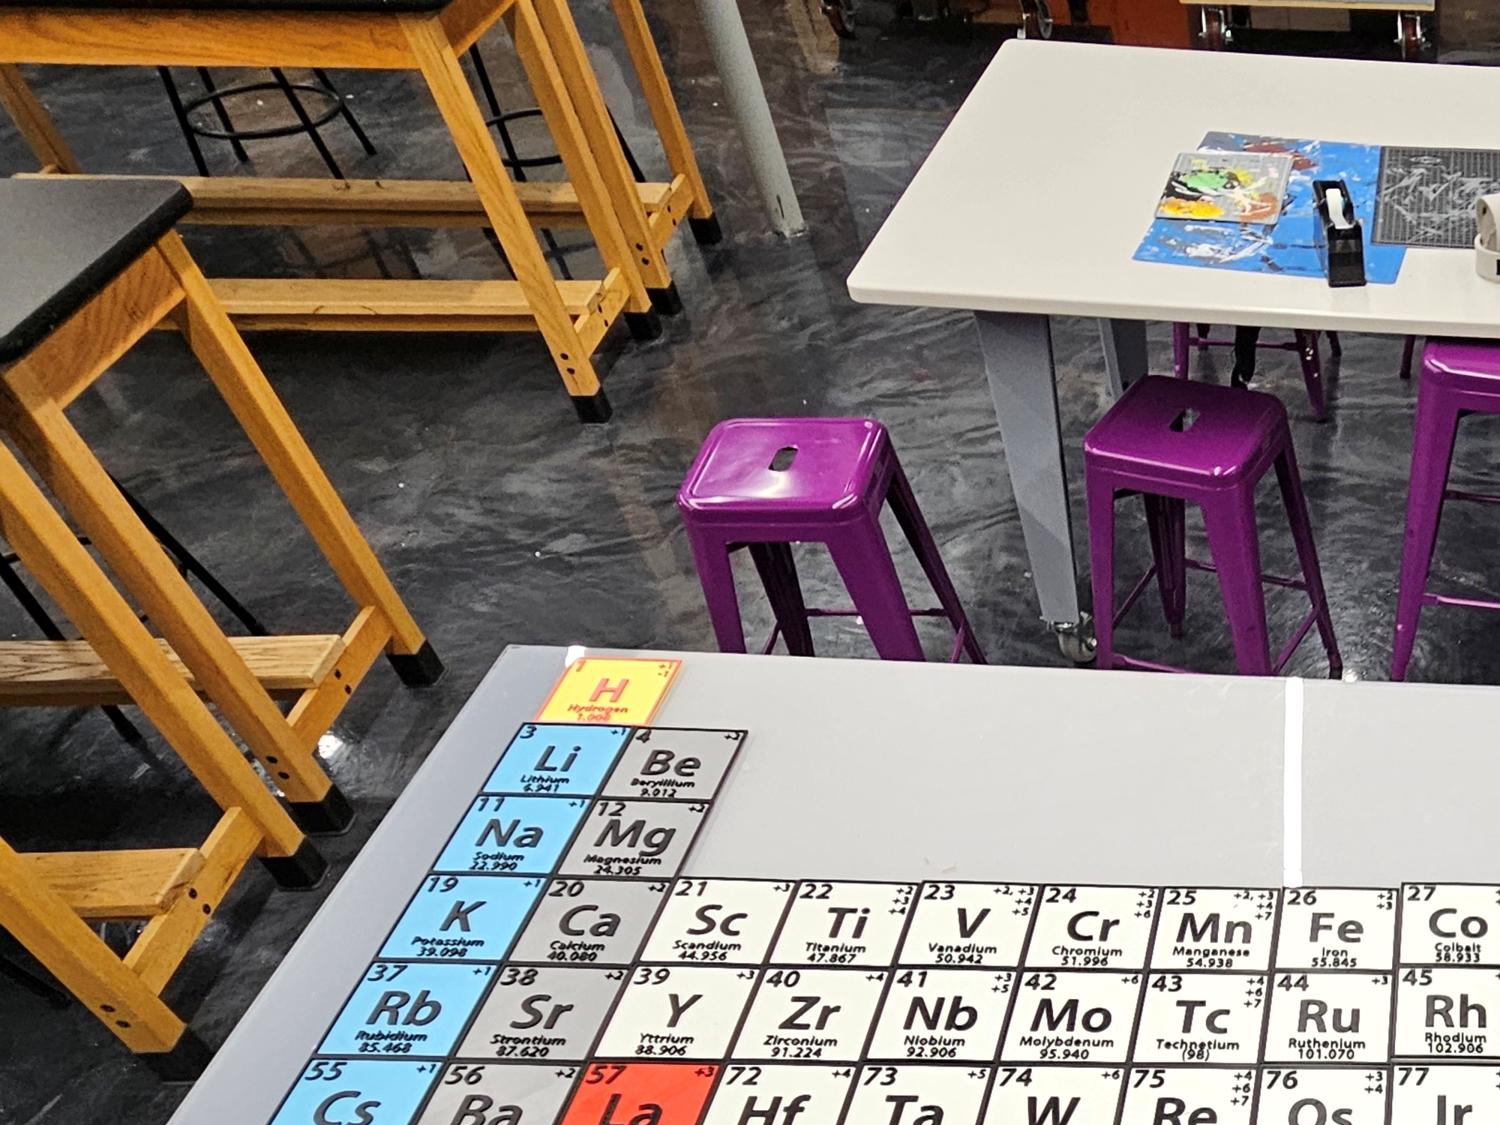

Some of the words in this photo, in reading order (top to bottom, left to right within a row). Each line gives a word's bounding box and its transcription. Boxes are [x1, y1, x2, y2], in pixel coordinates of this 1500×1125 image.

[589, 678, 630, 703] H
[534, 745, 582, 772] Li
[640, 749, 701, 777] Be
[475, 819, 544, 848] Na
[593, 819, 676, 857] Mg
[1407, 885, 1437, 902] 27
[439, 900, 487, 932] K
[828, 907, 871, 939] Ti
[1067, 910, 1120, 942] Cr
[1429, 908, 1488, 939] Co
[1309, 912, 1364, 943] Fe
[500, 968, 539, 986] 38
[766, 970, 801, 988] 40
[896, 970, 928, 988] 41
[510, 994, 574, 1030] Sr
[778, 996, 841, 1030] Zr
[903, 995, 978, 1031] Nb
[490, 1034, 566, 1046] Strontium
[763, 1035, 838, 1047] Zirconium
[904, 1035, 965, 1046] Niobium
[771, 1046, 822, 1058] 91.224
[906, 1046, 957, 1058] 92.906
[444, 1065, 485, 1085] 56
[726, 1066, 762, 1086] 72
[999, 1068, 1032, 1087] 74
[1133, 1069, 1166, 1088] 75
